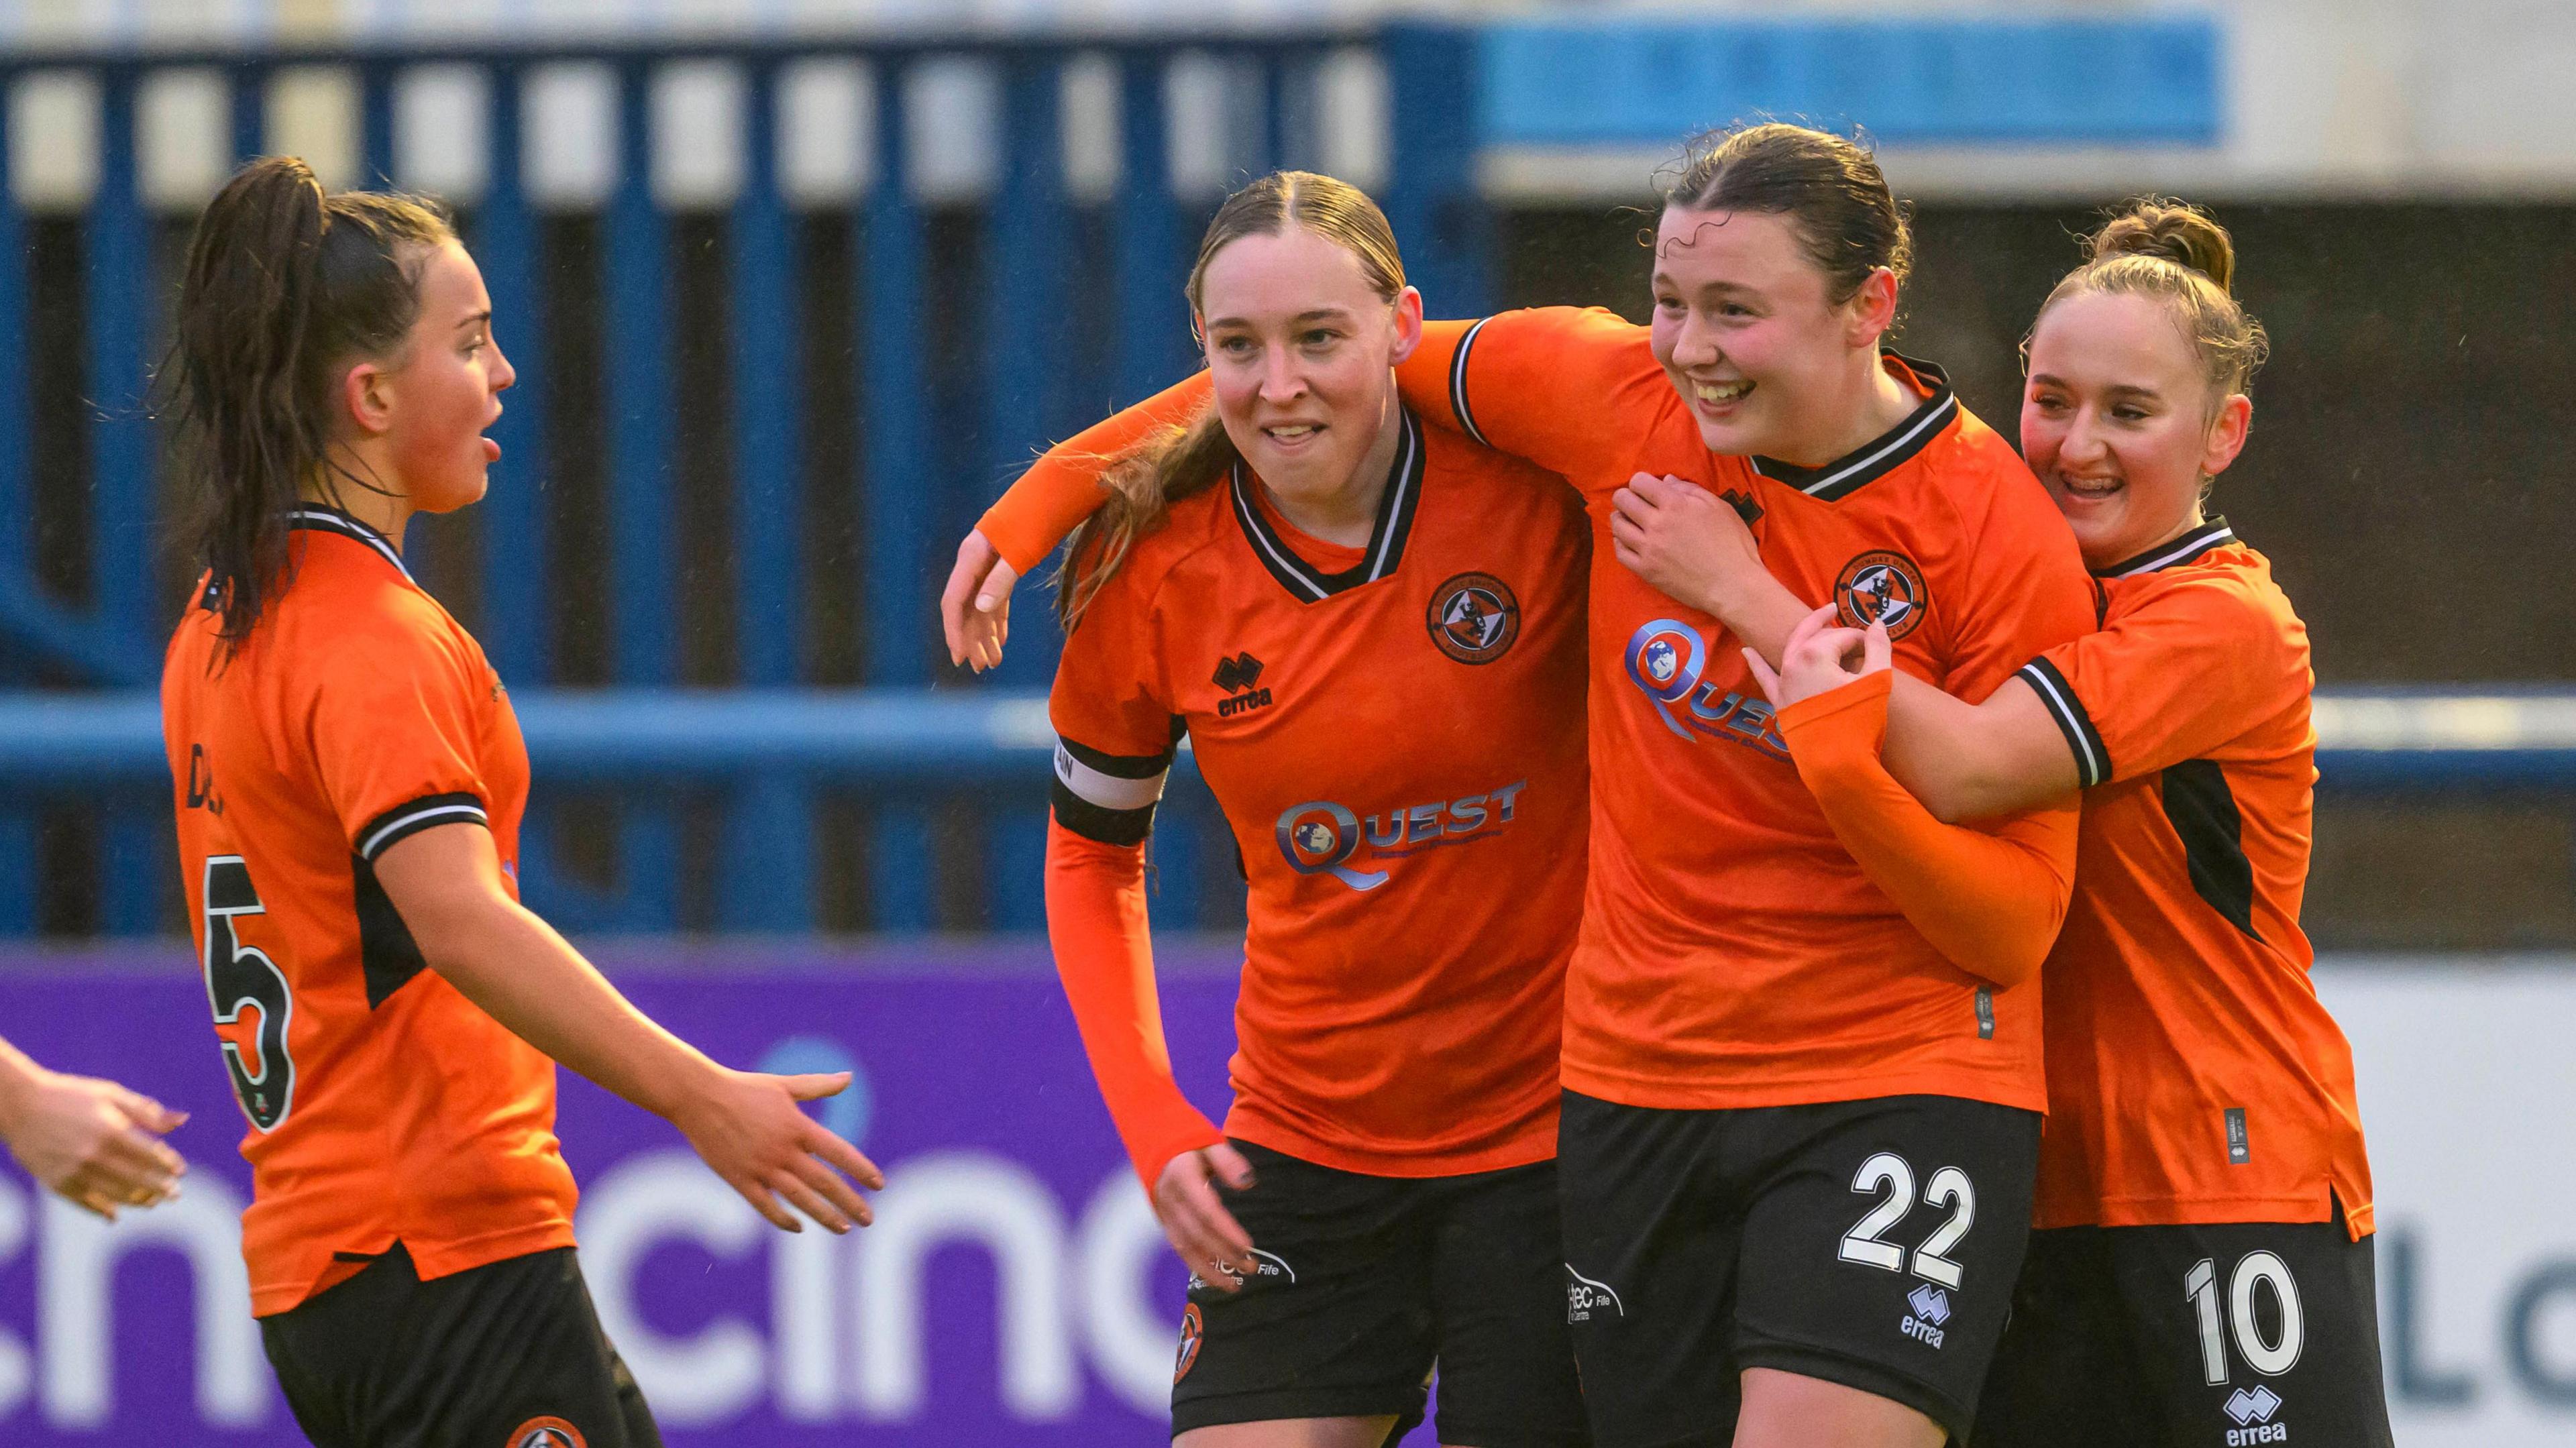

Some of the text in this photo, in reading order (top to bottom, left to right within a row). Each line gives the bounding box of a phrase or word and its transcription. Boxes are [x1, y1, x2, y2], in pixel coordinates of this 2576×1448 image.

[1218, 687, 1273, 717] errea
[1276, 779, 1528, 892] QUEST
[204, 854, 295, 1134] 5
[1838, 1152, 1975, 1291] 22
[1257, 1264, 1279, 1276] Fife
[1900, 1315, 1944, 1349] errea
[2185, 1249, 2304, 1386] 10
[2226, 1422, 2287, 1447] errea
